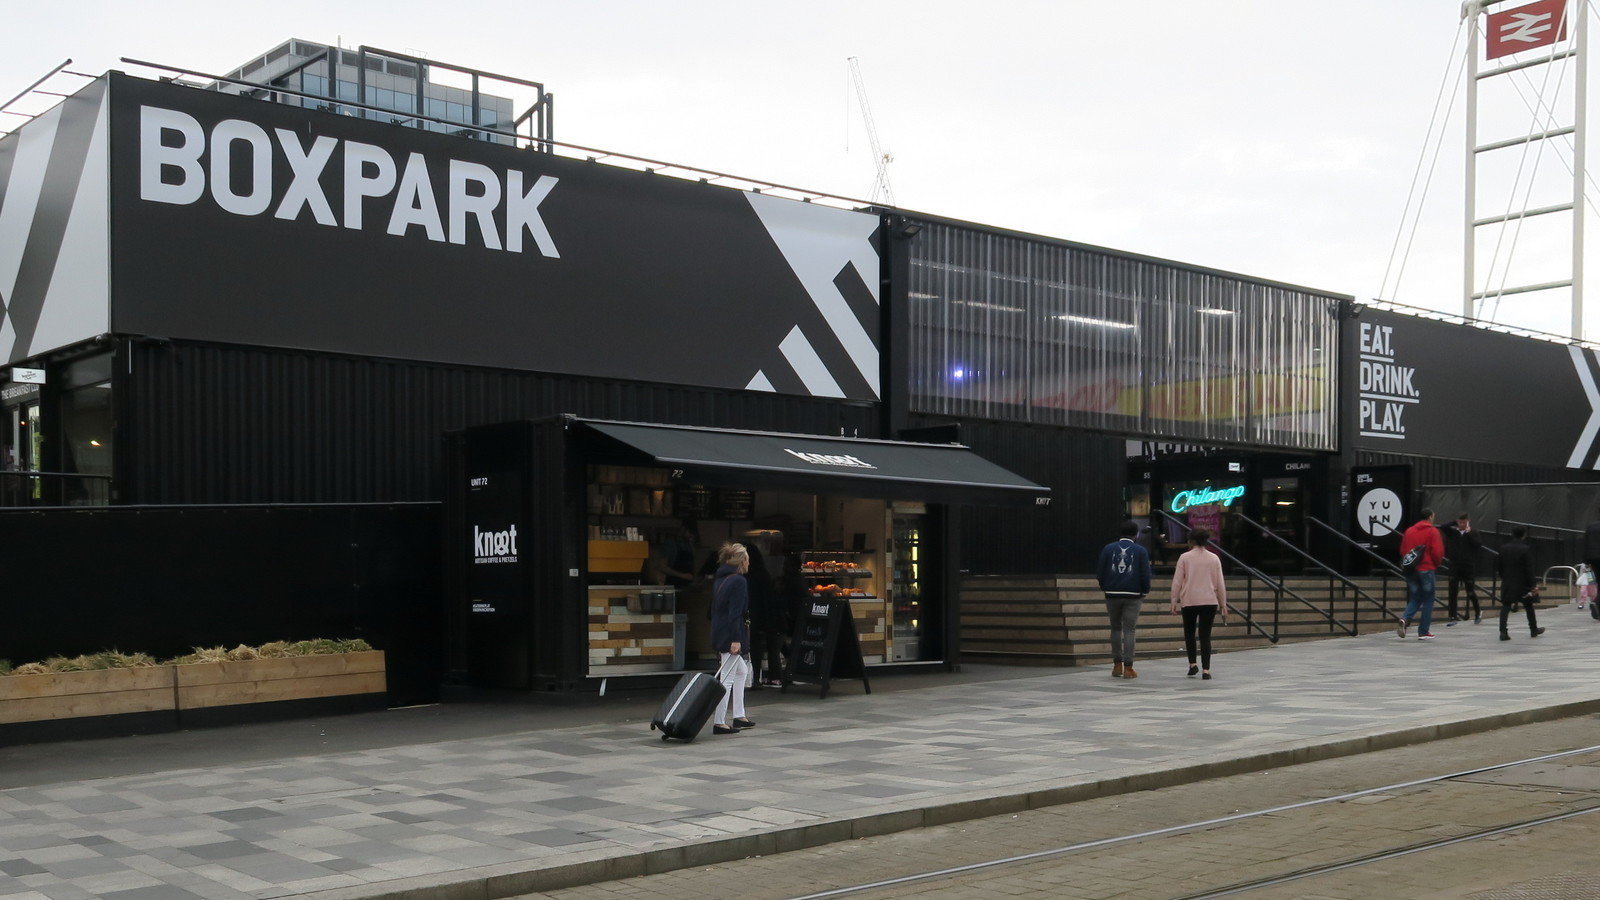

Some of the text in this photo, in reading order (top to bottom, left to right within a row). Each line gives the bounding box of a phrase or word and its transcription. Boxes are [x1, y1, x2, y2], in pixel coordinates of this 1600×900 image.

[140, 105, 560, 258] BOXPARK
[1360, 322, 1395, 356] EAT.
[1360, 361, 1420, 397] DRINK.
[1360, 400, 1405, 433] PLAY.
[470, 477, 488, 486] UNIT 72
[671, 469, 684, 478] 72
[1171, 485, 1245, 513] Chilango
[474, 524, 517, 557] knot
